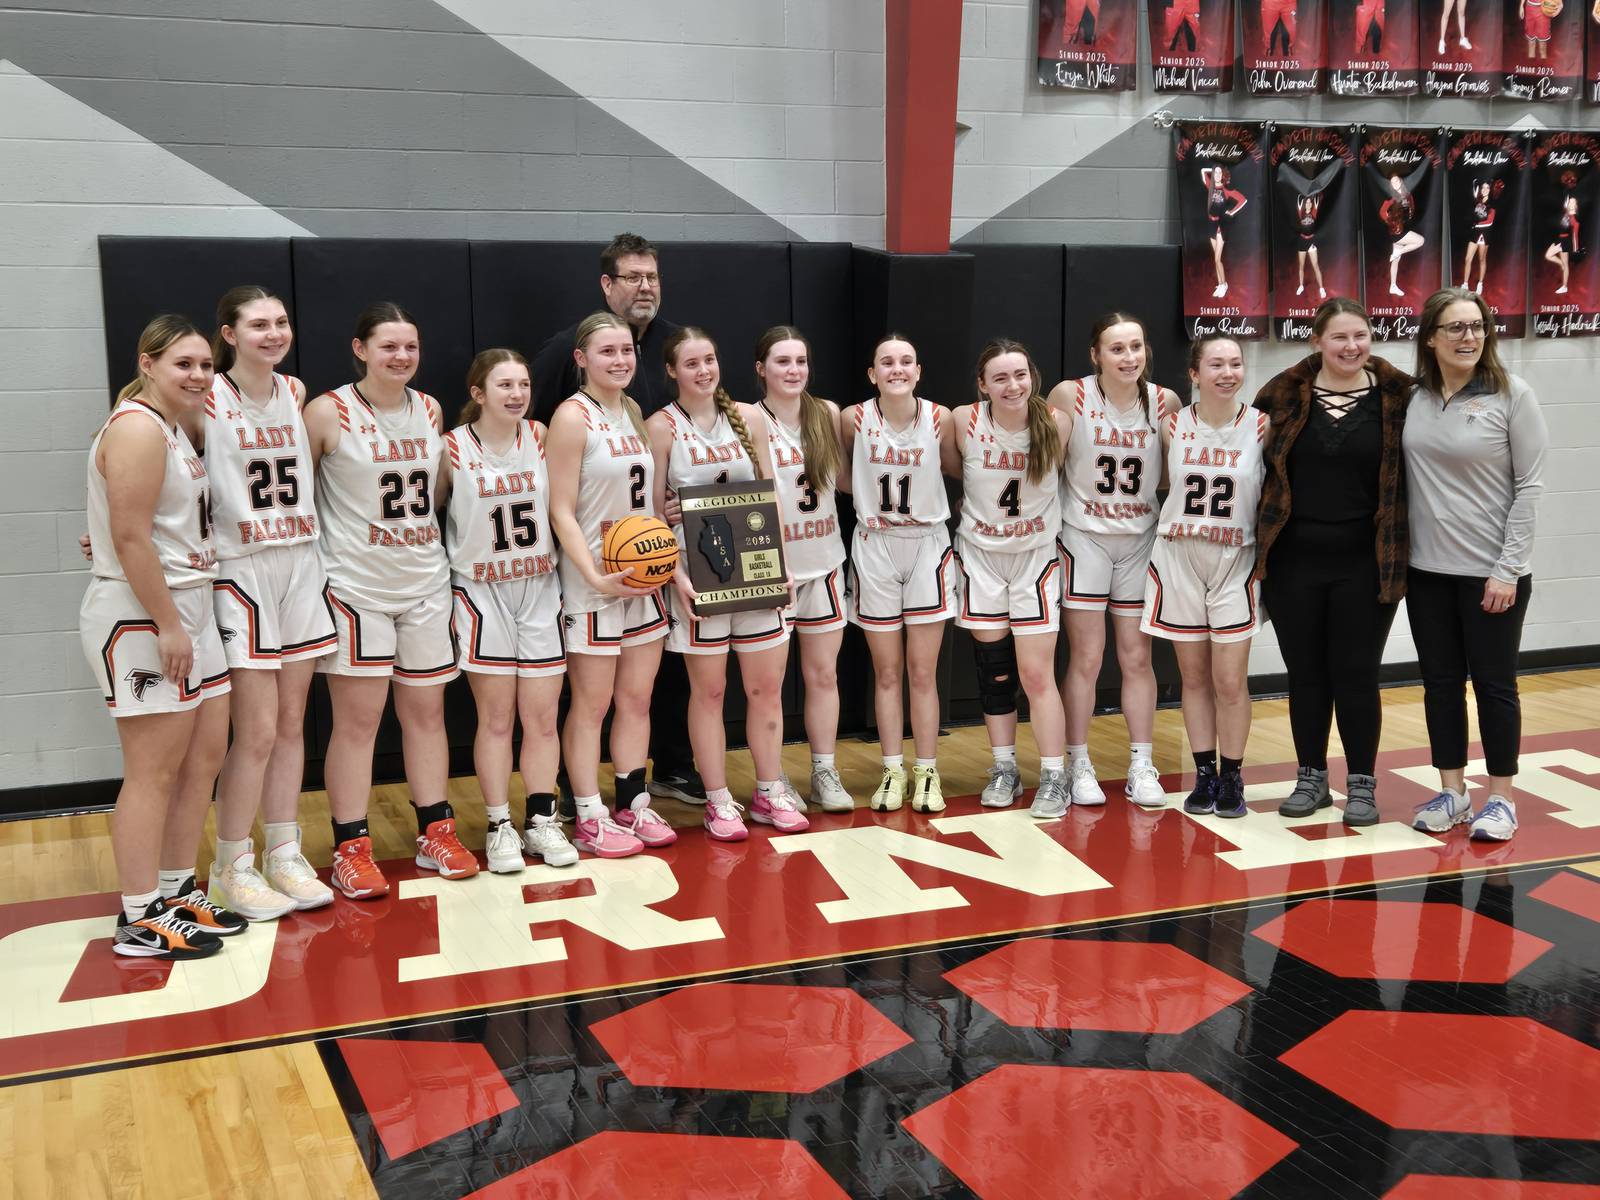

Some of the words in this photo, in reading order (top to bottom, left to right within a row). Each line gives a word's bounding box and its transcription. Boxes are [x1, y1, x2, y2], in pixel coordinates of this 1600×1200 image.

[1086, 52, 1106, 62] 2025
[1185, 57, 1205, 67] 2025
[1280, 60, 1300, 69] 2025
[1371, 61, 1390, 70] 2025
[1454, 62, 1473, 72] 2025
[1087, 62, 1119, 88] White
[1155, 66, 1190, 89] Michael
[1250, 69, 1272, 93] John
[1332, 69, 1361, 94] Hunter
[1536, 66, 1554, 75] 2025
[1221, 307, 1240, 316] 2025
[1394, 307, 1413, 316] 2025
[1561, 304, 1580, 313] 2025
[236, 424, 296, 450] LADY
[1093, 426, 1149, 449] LADY
[369, 437, 429, 463] LADY
[688, 440, 744, 466] LADY
[775, 447, 804, 468] LA
[869, 443, 925, 467] LADY
[983, 449, 1029, 472] LAD
[1183, 446, 1242, 468] LADY
[246, 455, 300, 512] 25
[476, 470, 536, 498] LADY
[1094, 452, 1145, 497] 33
[377, 467, 431, 520] 23
[628, 462, 647, 512] 2
[794, 471, 821, 515] 3
[878, 471, 912, 517] 11
[997, 477, 1022, 519] 4
[1183, 471, 1237, 520] 22
[693, 492, 766, 509] REGIONAL
[488, 500, 540, 554] 15
[784, 514, 836, 543] ALCON
[633, 535, 678, 555] Wilson
[473, 553, 553, 584] FALCON
[645, 559, 677, 576] NCAA
[699, 585, 785, 603] CHAMPIONS
